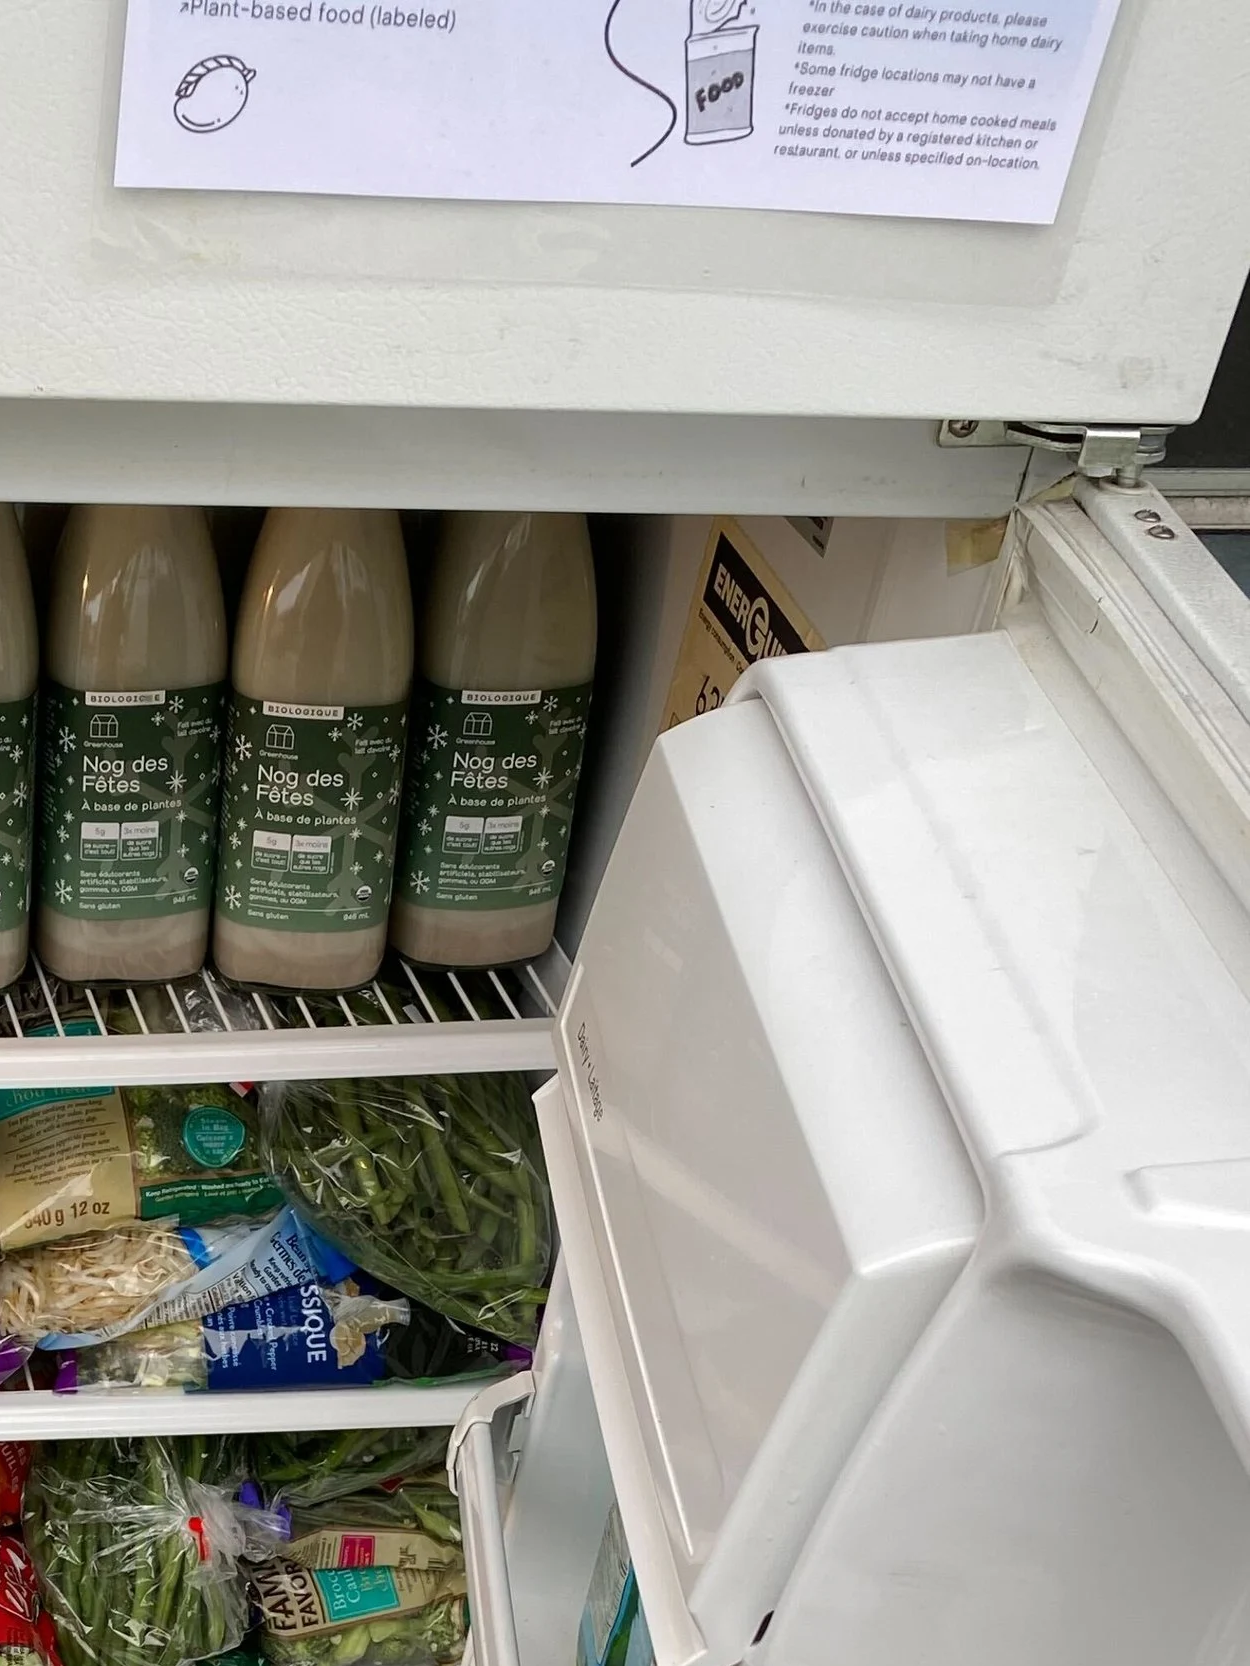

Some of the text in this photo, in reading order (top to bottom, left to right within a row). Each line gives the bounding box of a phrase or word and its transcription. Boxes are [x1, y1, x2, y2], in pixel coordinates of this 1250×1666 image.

[319, 5, 363, 24] food
[370, 5, 456, 33] (labeled)
[830, 1, 850, 14] the
[854, 5, 884, 17] case
[889, 2, 903, 17] of
[905, 5, 938, 22] dairy
[1004, 12, 1047, 28] please
[798, 40, 836, 56] items.
[803, 22, 1063, 52] exercise caution when taking home dairy
[840, 64, 878, 81] fridge
[882, 66, 939, 82] locations
[942, 72, 968, 86] may
[971, 73, 992, 86] not
[996, 74, 1025, 88] have
[1028, 79, 1036, 89] a
[695, 71, 744, 112] FOOD
[788, 84, 835, 97] freezer
[841, 106, 857, 119] do
[861, 107, 882, 120] not
[884, 109, 930, 124] accept
[933, 112, 967, 126] home
[970, 115, 1018, 129] cooked
[1020, 117, 1057, 131] meals
[779, 124, 1038, 150] unless donated by registered kitchen or
[845, 149, 857, 160] or
[861, 148, 901, 162] unless
[904, 150, 962, 167] specified
[966, 154, 1039, 170] on-location.
[268, 705, 338, 717] BIOLOGIQUE
[83, 755, 168, 777] Nog des
[453, 751, 537, 774] Nog des
[82, 775, 140, 793] Fêtes
[258, 764, 344, 789] Nog des
[451, 770, 508, 789] Fêtes
[81, 798, 182, 812] À base de plantes
[256, 784, 314, 806] Fêtes
[448, 793, 547, 807] À base de plantes
[255, 807, 356, 826] À base de plantes
[578, 1022, 603, 1121] Dairy Laitage
[55, 1208, 64, 1226] g
[70, 1201, 87, 1218] 12
[92, 1202, 110, 1215] oz
[300, 1284, 326, 1363] SSIQUE
[267, 1341, 277, 1370] Pepper
[286, 1560, 318, 1628] FAVOR
